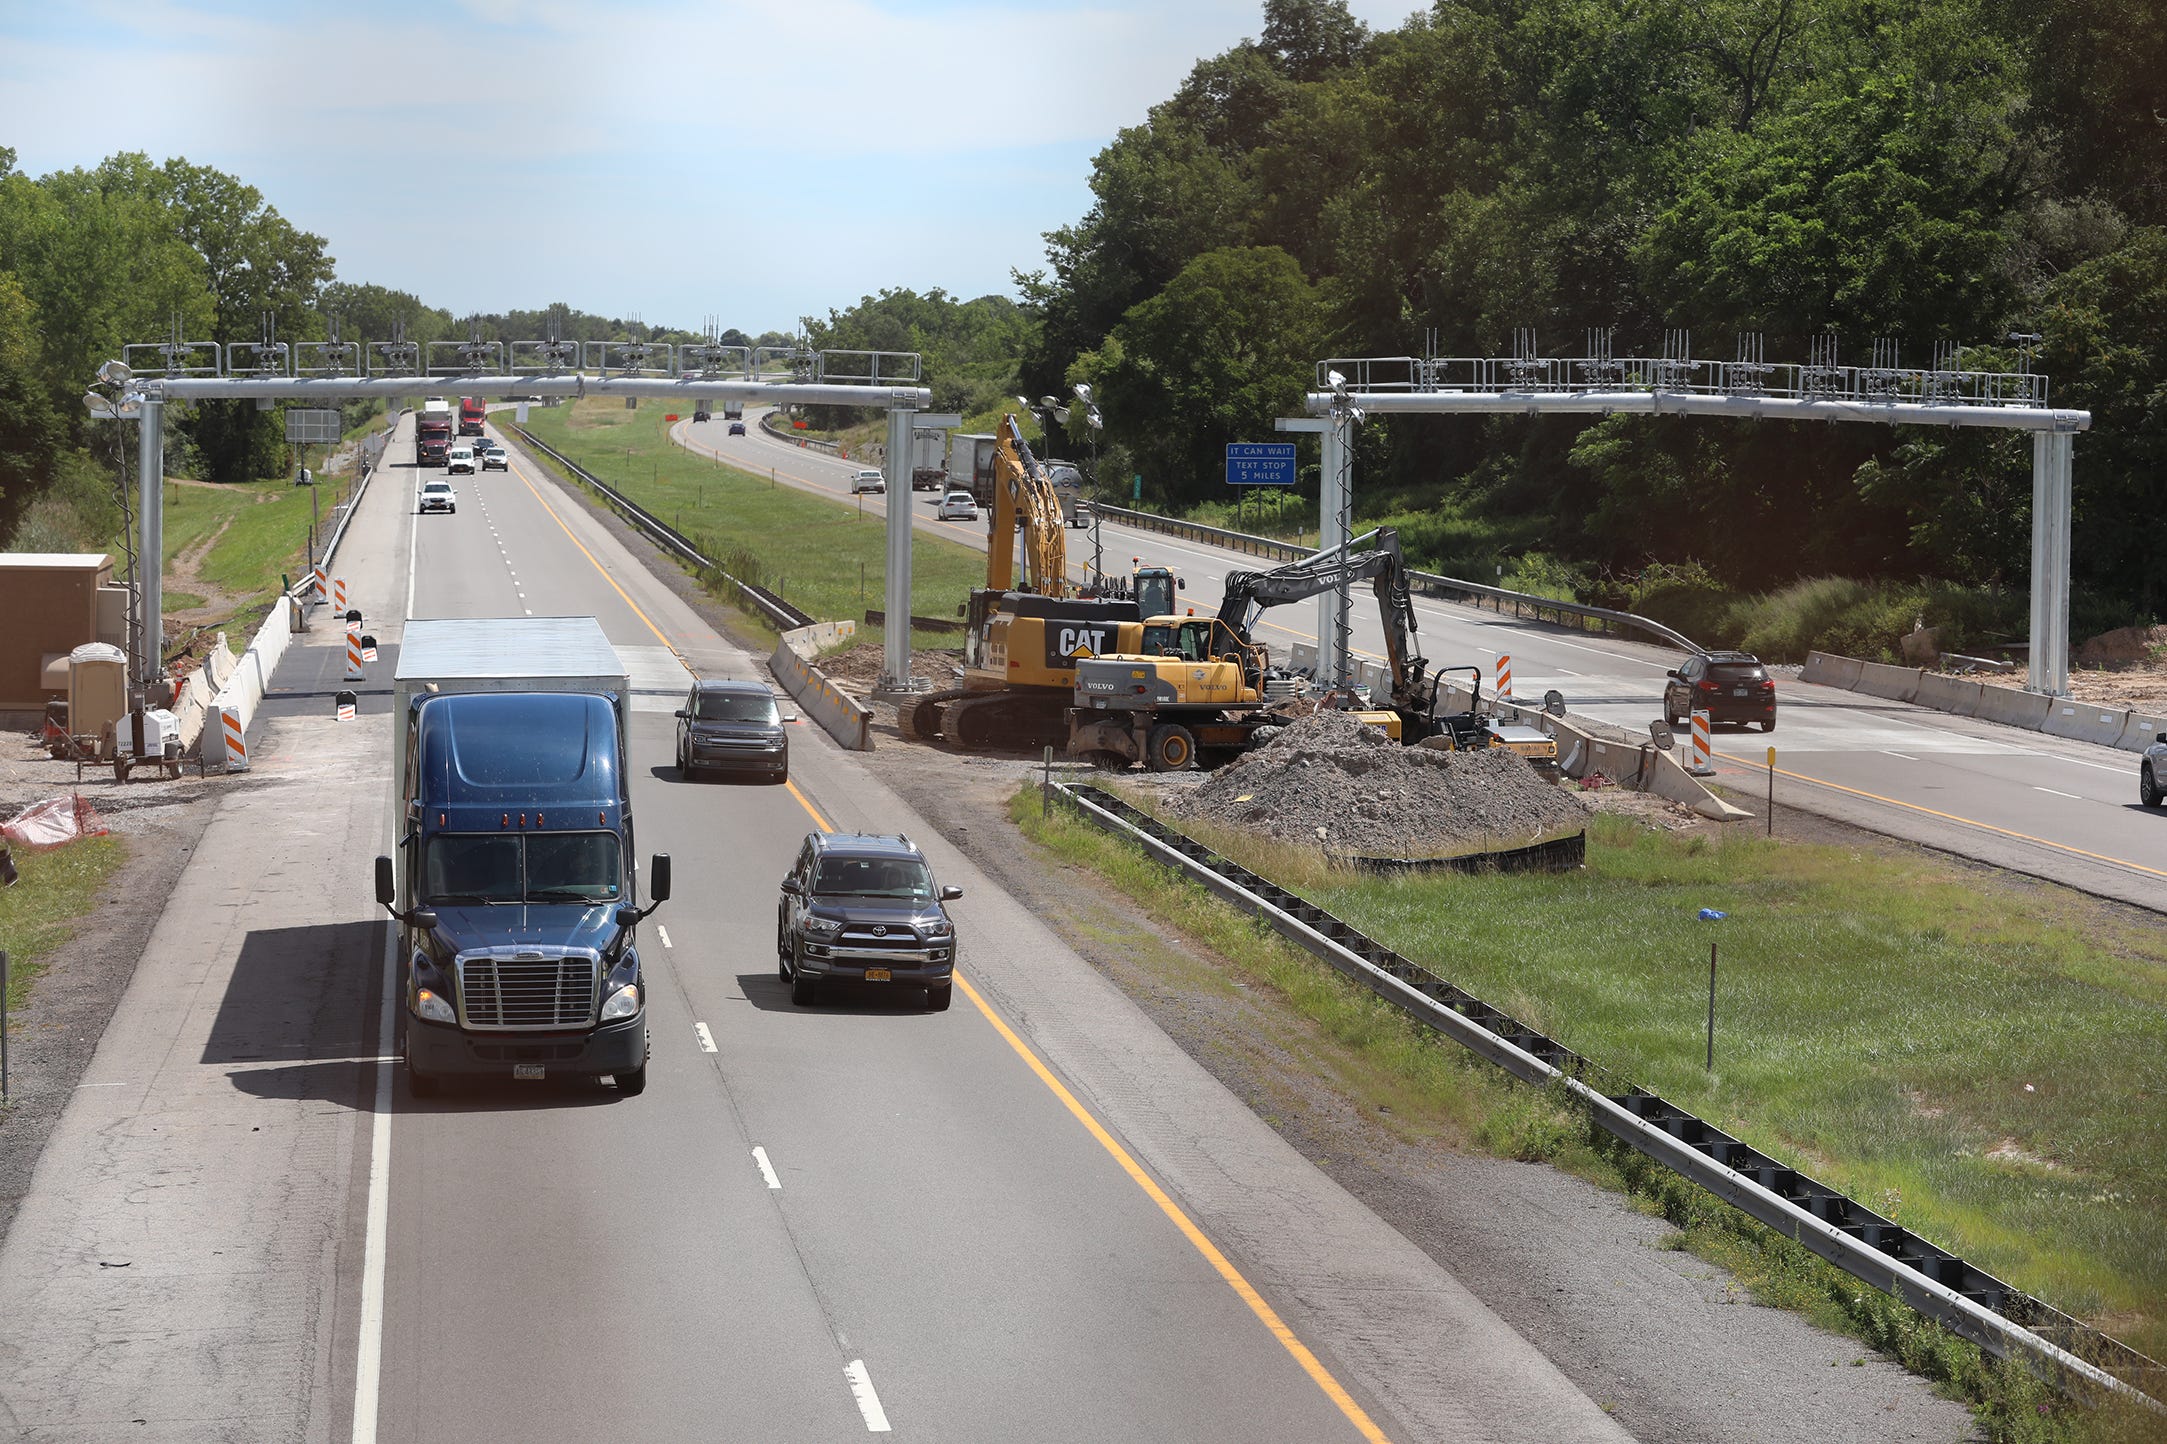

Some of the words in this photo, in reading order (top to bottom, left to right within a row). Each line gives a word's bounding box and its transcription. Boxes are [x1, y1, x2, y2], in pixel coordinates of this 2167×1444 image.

[1253, 472, 1281, 480] MILES
[1317, 570, 1354, 585] VOLO
[1060, 628, 1105, 656] CAT
[1087, 682, 1114, 690] VOLVO
